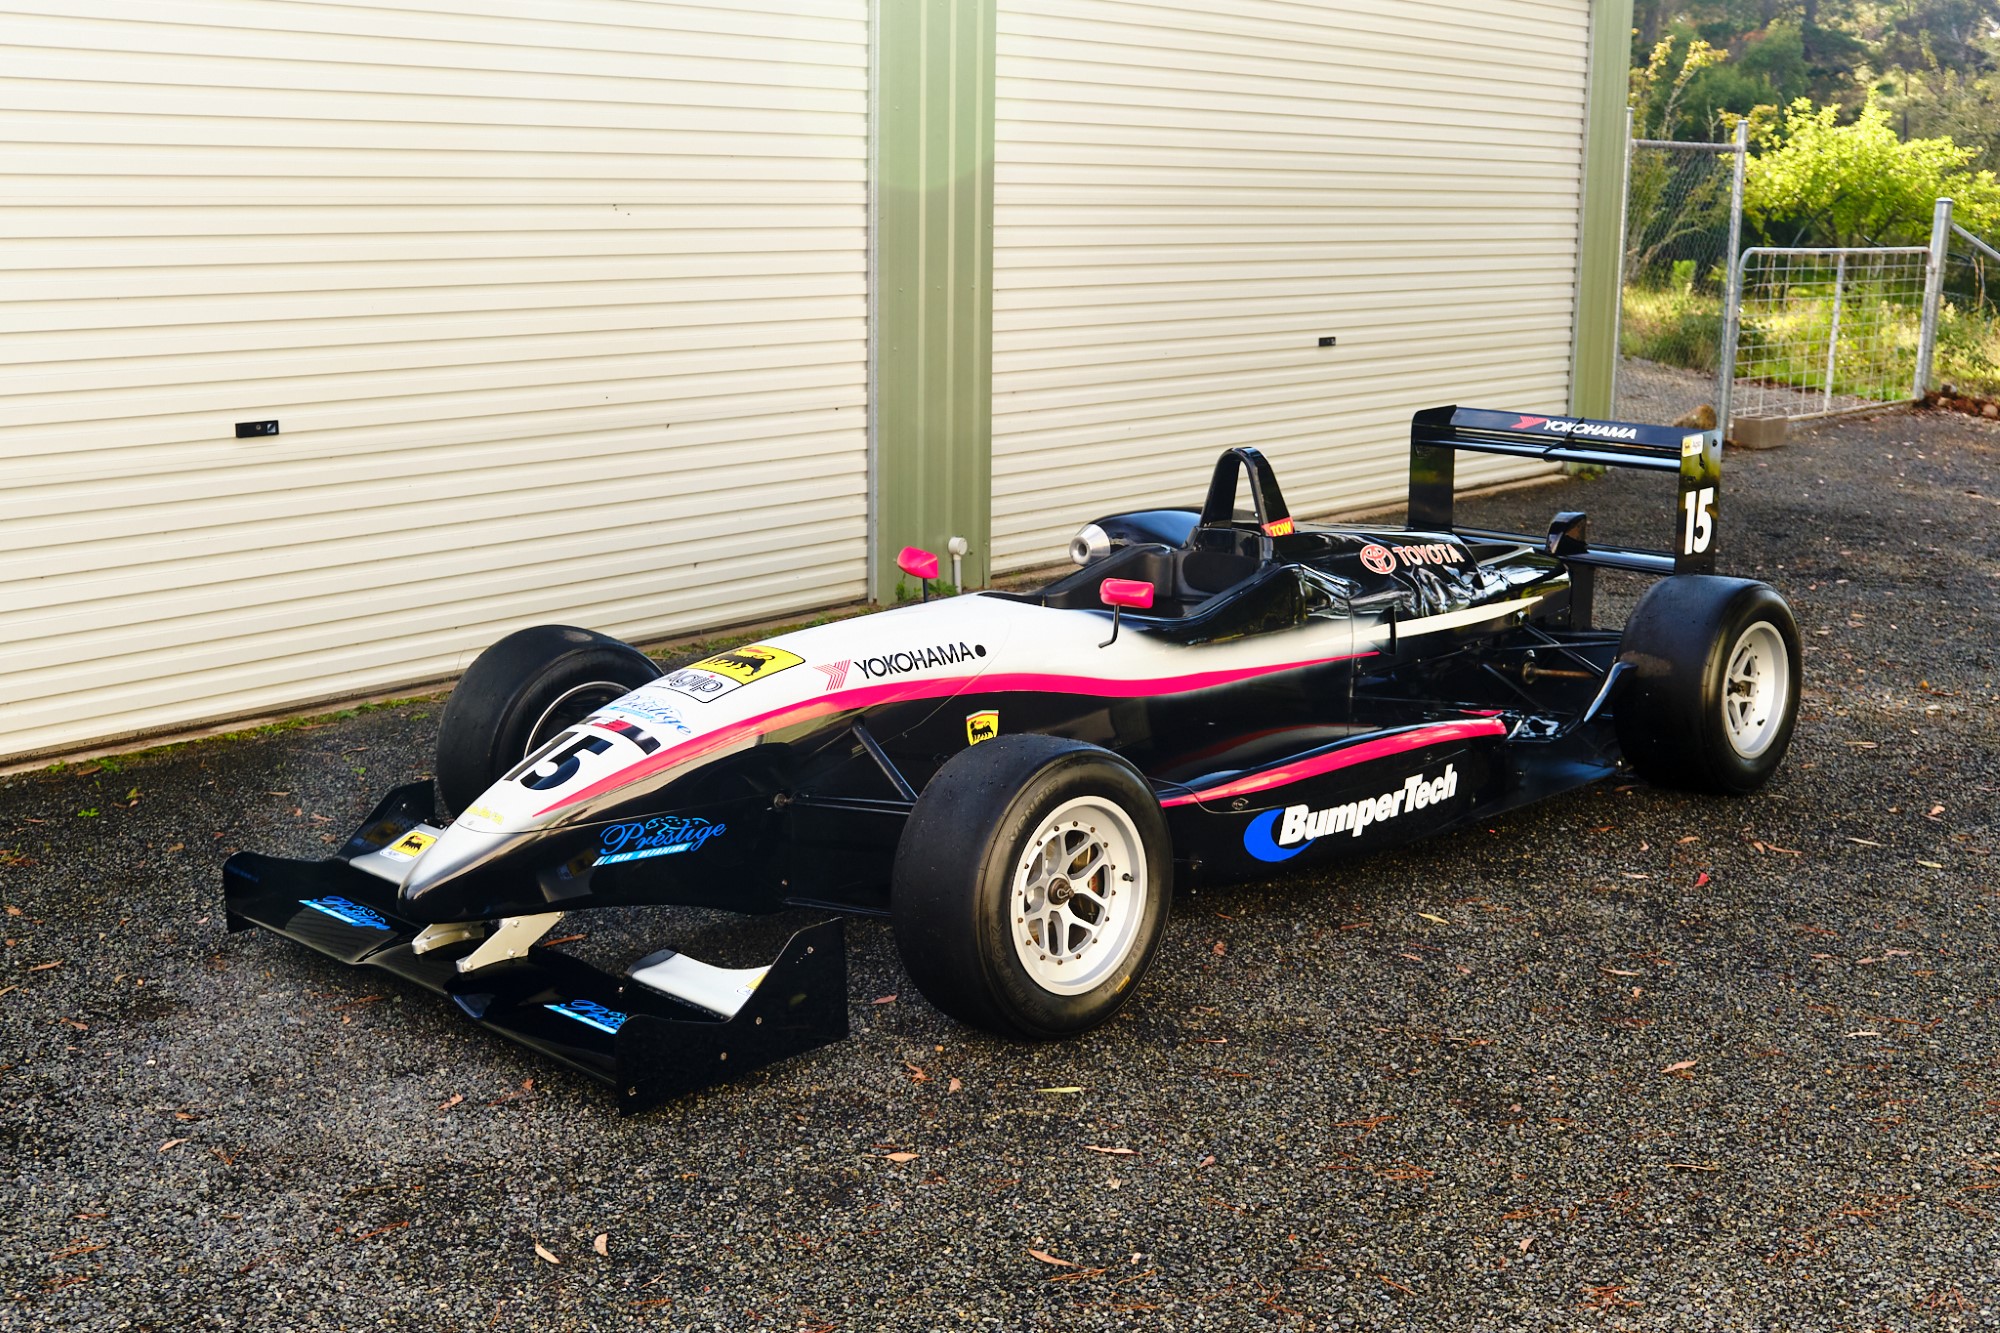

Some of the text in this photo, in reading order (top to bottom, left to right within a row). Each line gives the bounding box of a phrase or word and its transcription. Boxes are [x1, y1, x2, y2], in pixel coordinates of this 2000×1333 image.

[1543, 420, 1638, 440] YOKOHAMA
[1269, 521, 1292, 537] TOW
[1684, 486, 1715, 556] 15
[1393, 543, 1466, 567] TOYOTA
[853, 641, 976, 680] YOKOHAMA
[503, 731, 615, 791] 15
[1278, 763, 1459, 846] BumperTech
[600, 821, 728, 855] Prestige
